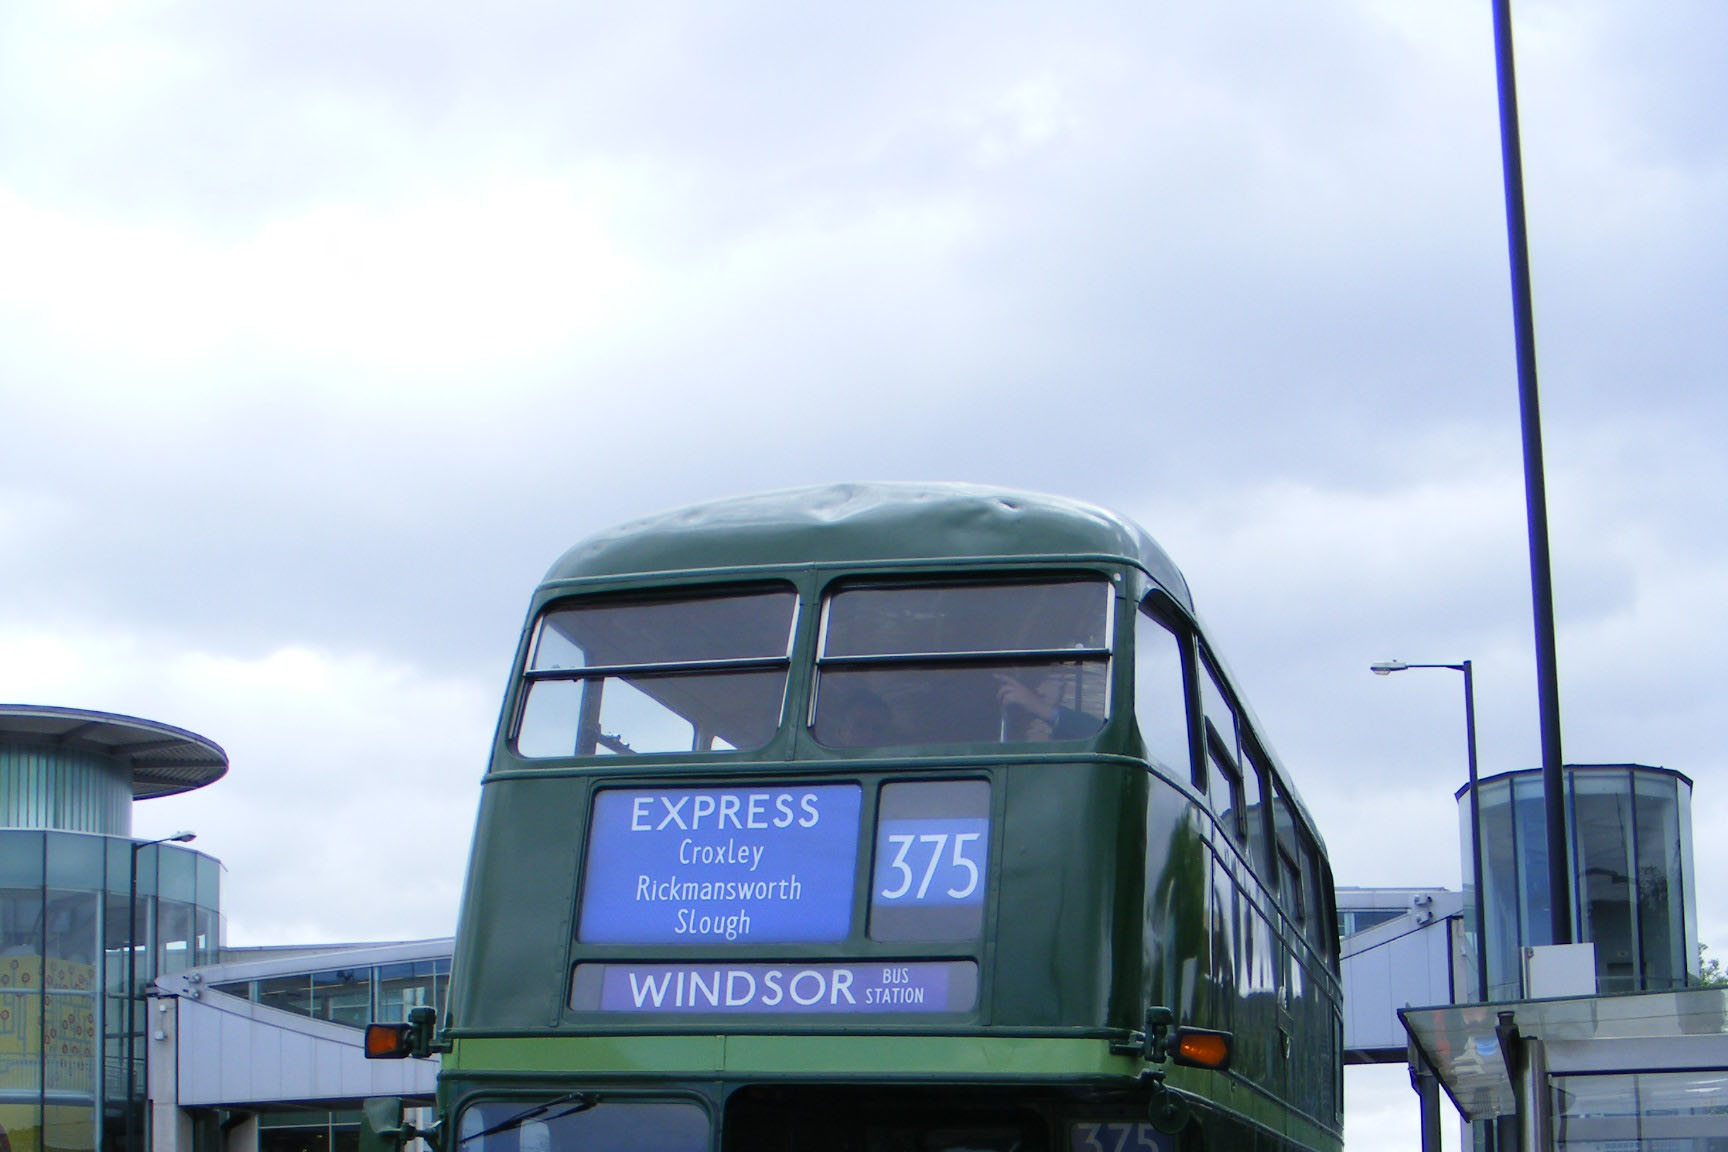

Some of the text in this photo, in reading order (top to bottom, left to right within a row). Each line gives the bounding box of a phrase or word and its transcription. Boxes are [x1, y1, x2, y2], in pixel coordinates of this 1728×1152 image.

[631, 793, 820, 832] EXPRESS
[679, 838, 765, 872] Croxley
[881, 832, 981, 899] 375
[636, 874, 801, 902] Rickmansworth
[674, 908, 751, 941] Slough
[629, 969, 857, 1008] WINDSOR
[882, 967, 910, 984] BUS
[865, 986, 925, 1005] STATION
